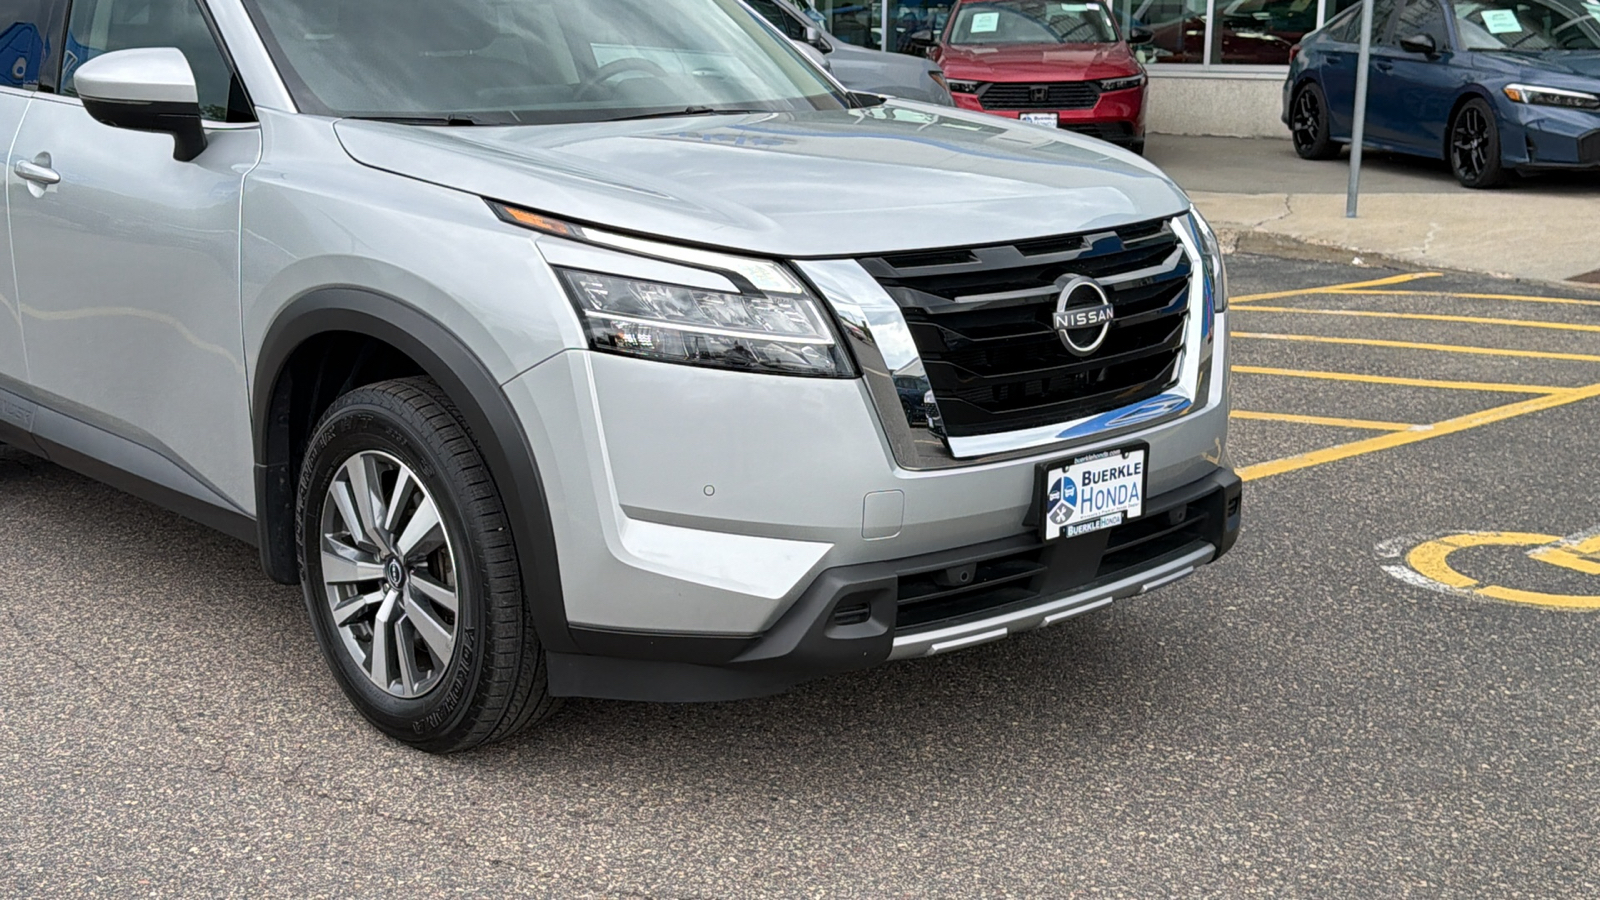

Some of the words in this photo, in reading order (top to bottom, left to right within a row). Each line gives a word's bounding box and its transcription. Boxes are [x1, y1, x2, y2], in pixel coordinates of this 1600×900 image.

[1056, 308, 1114, 328] NISSAN
[1082, 462, 1142, 487] BUERKLE
[1080, 481, 1140, 514] HONDA
[1067, 520, 1100, 536] BUERKLE
[1101, 514, 1121, 527] HONDA
